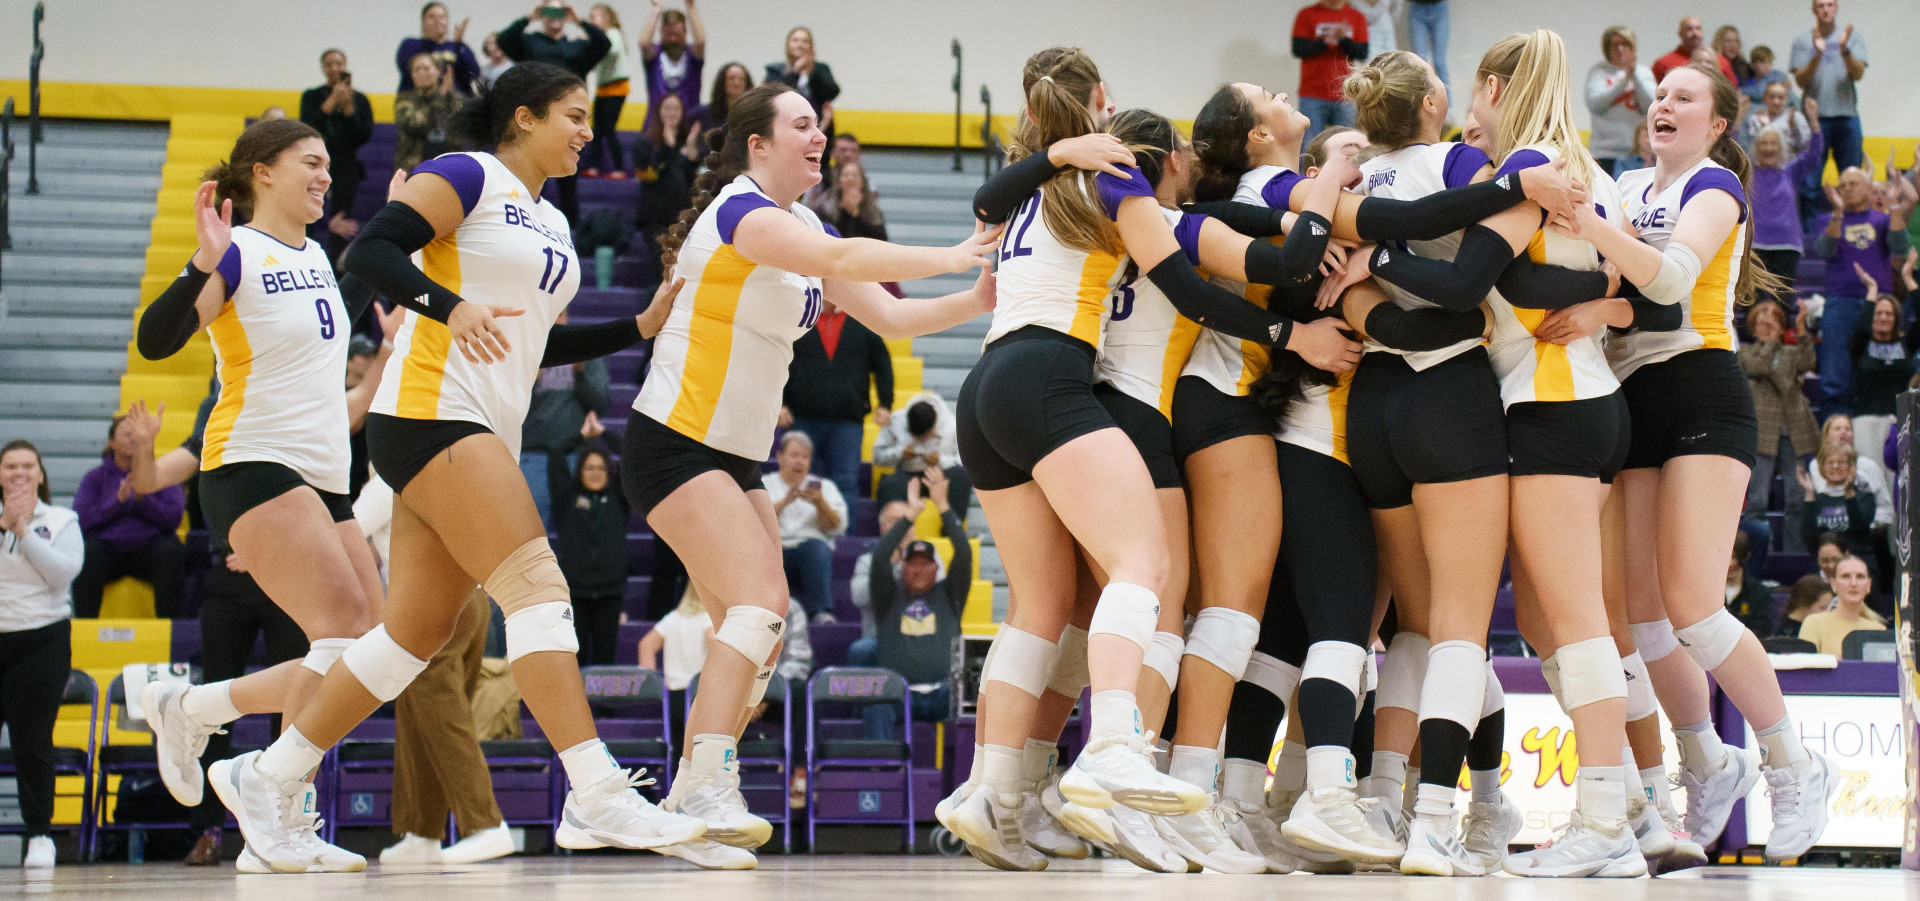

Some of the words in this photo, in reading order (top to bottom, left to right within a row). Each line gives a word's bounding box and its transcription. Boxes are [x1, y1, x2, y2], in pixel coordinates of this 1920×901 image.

[504, 203, 575, 250] BELLEVU
[1000, 189, 1033, 263] 22
[261, 268, 338, 294] BELLEVU
[538, 246, 569, 295] 17
[315, 298, 335, 340] 9
[797, 286, 822, 329] 10
[585, 674, 647, 697] WEST
[828, 675, 889, 697] WEST
[1799, 721, 1902, 757] HOM
